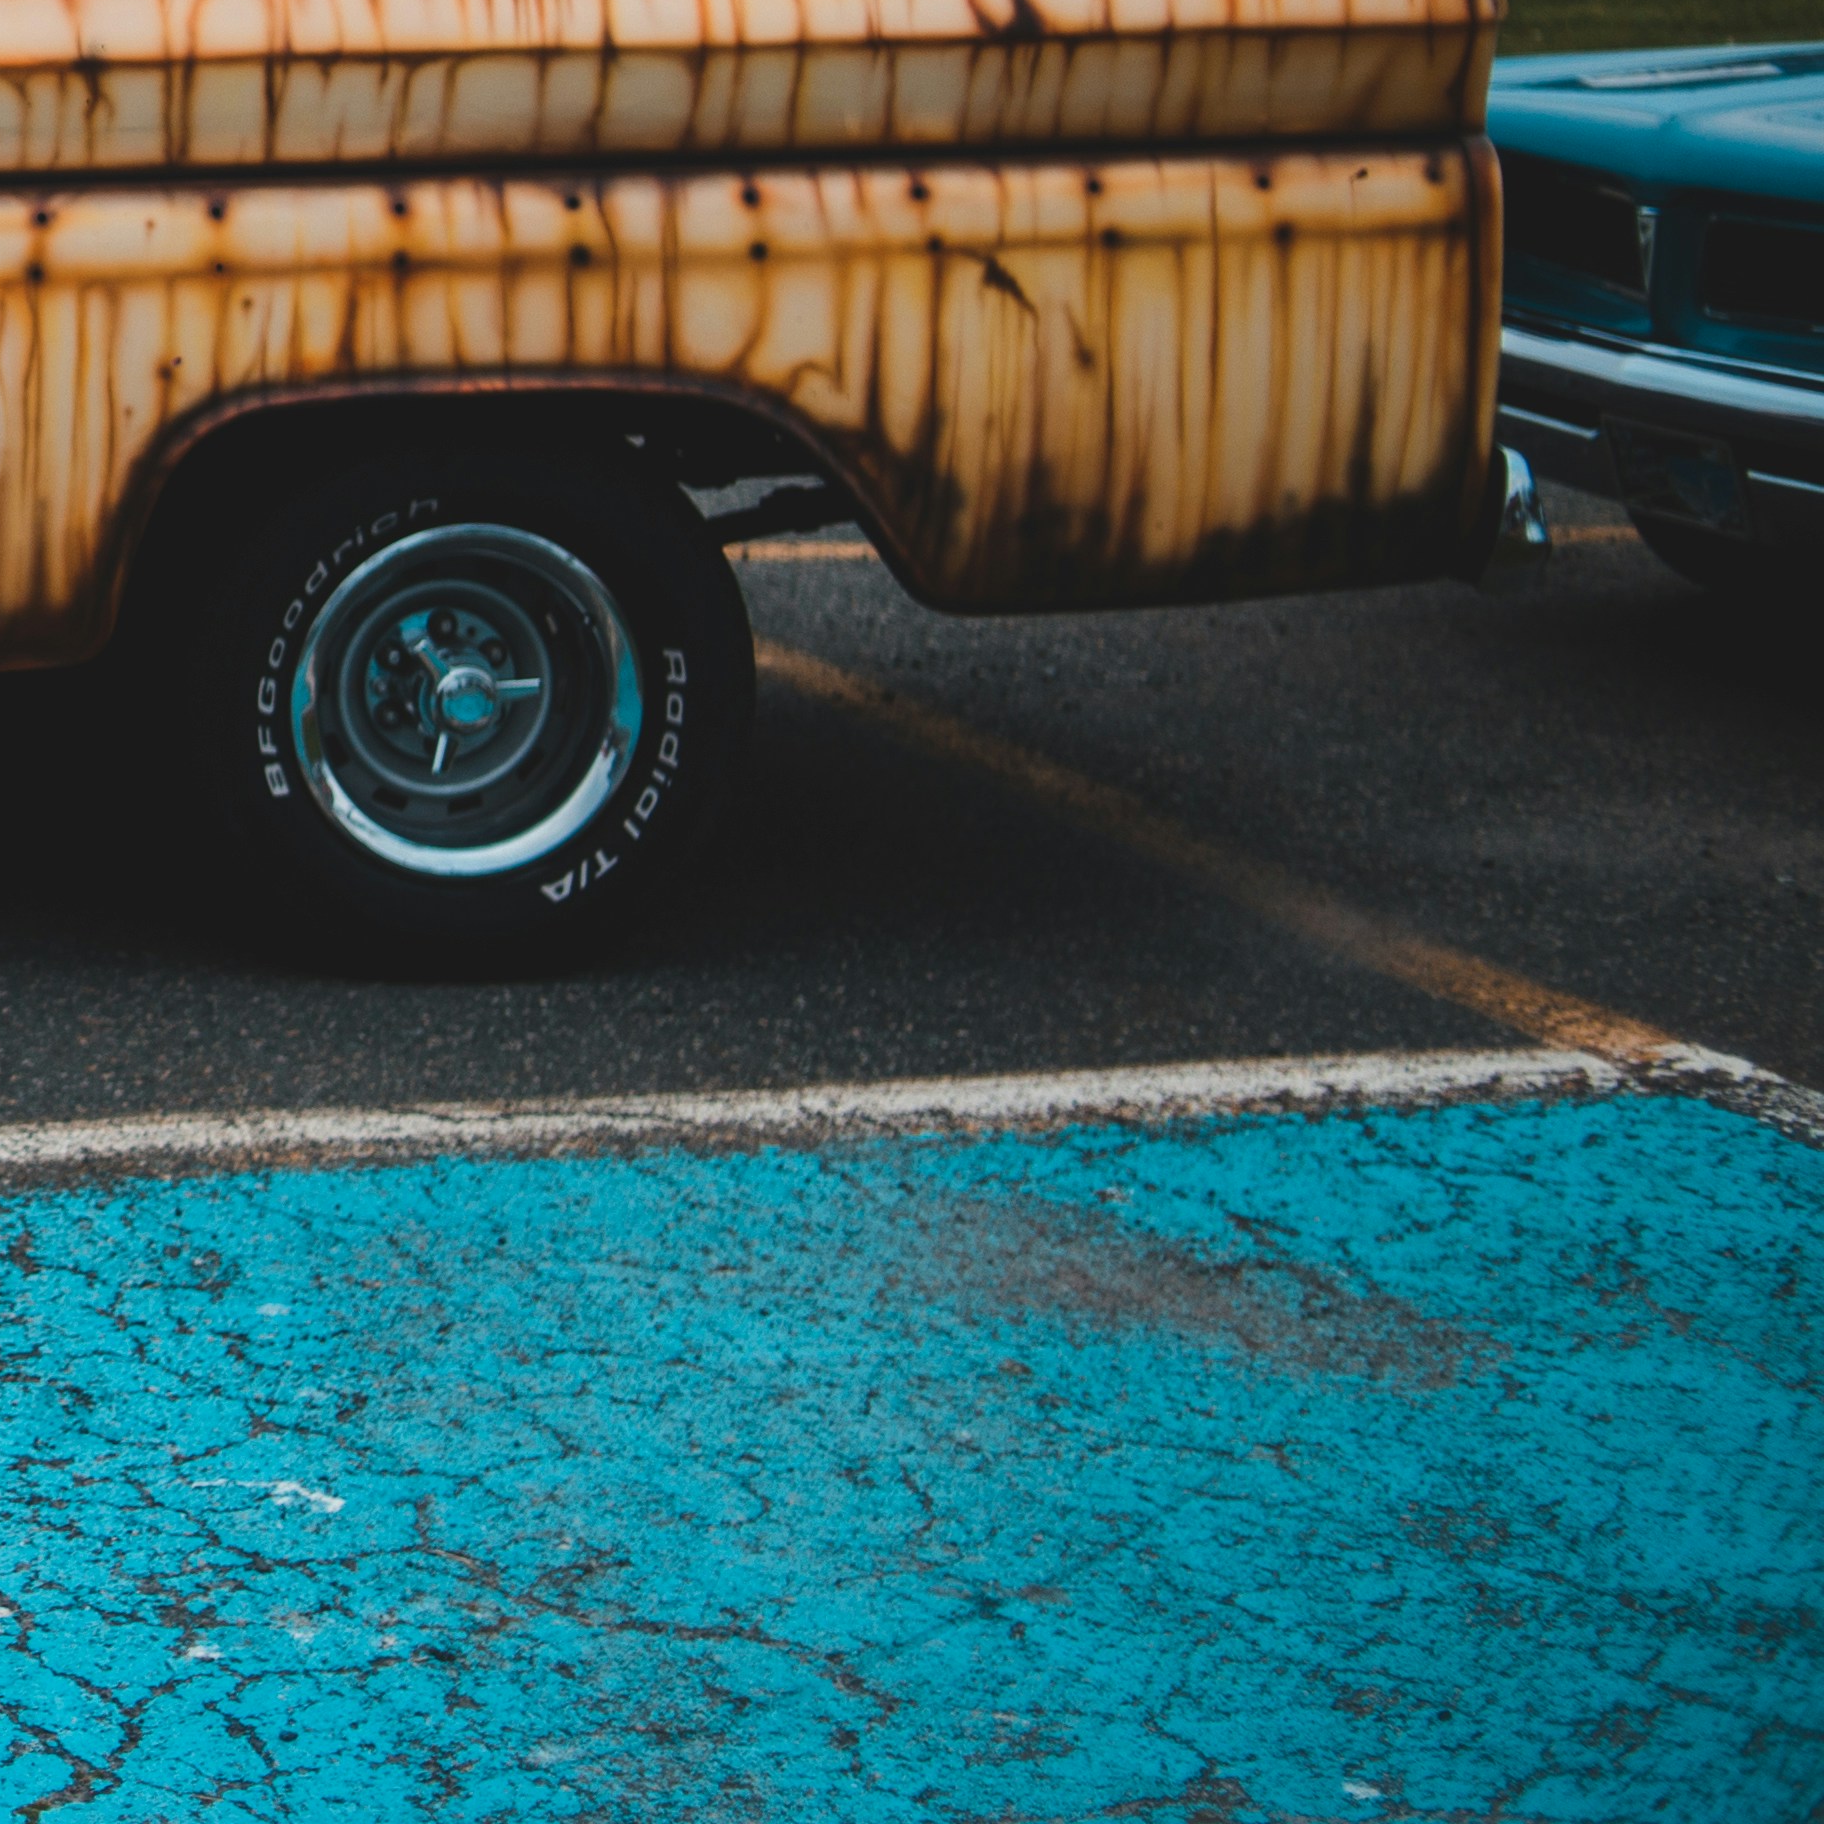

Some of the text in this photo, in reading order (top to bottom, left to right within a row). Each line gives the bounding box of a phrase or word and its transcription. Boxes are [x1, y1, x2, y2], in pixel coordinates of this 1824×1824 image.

[257, 497, 439, 798] BFGoodrich
[539, 648, 687, 902] Radial T/A
